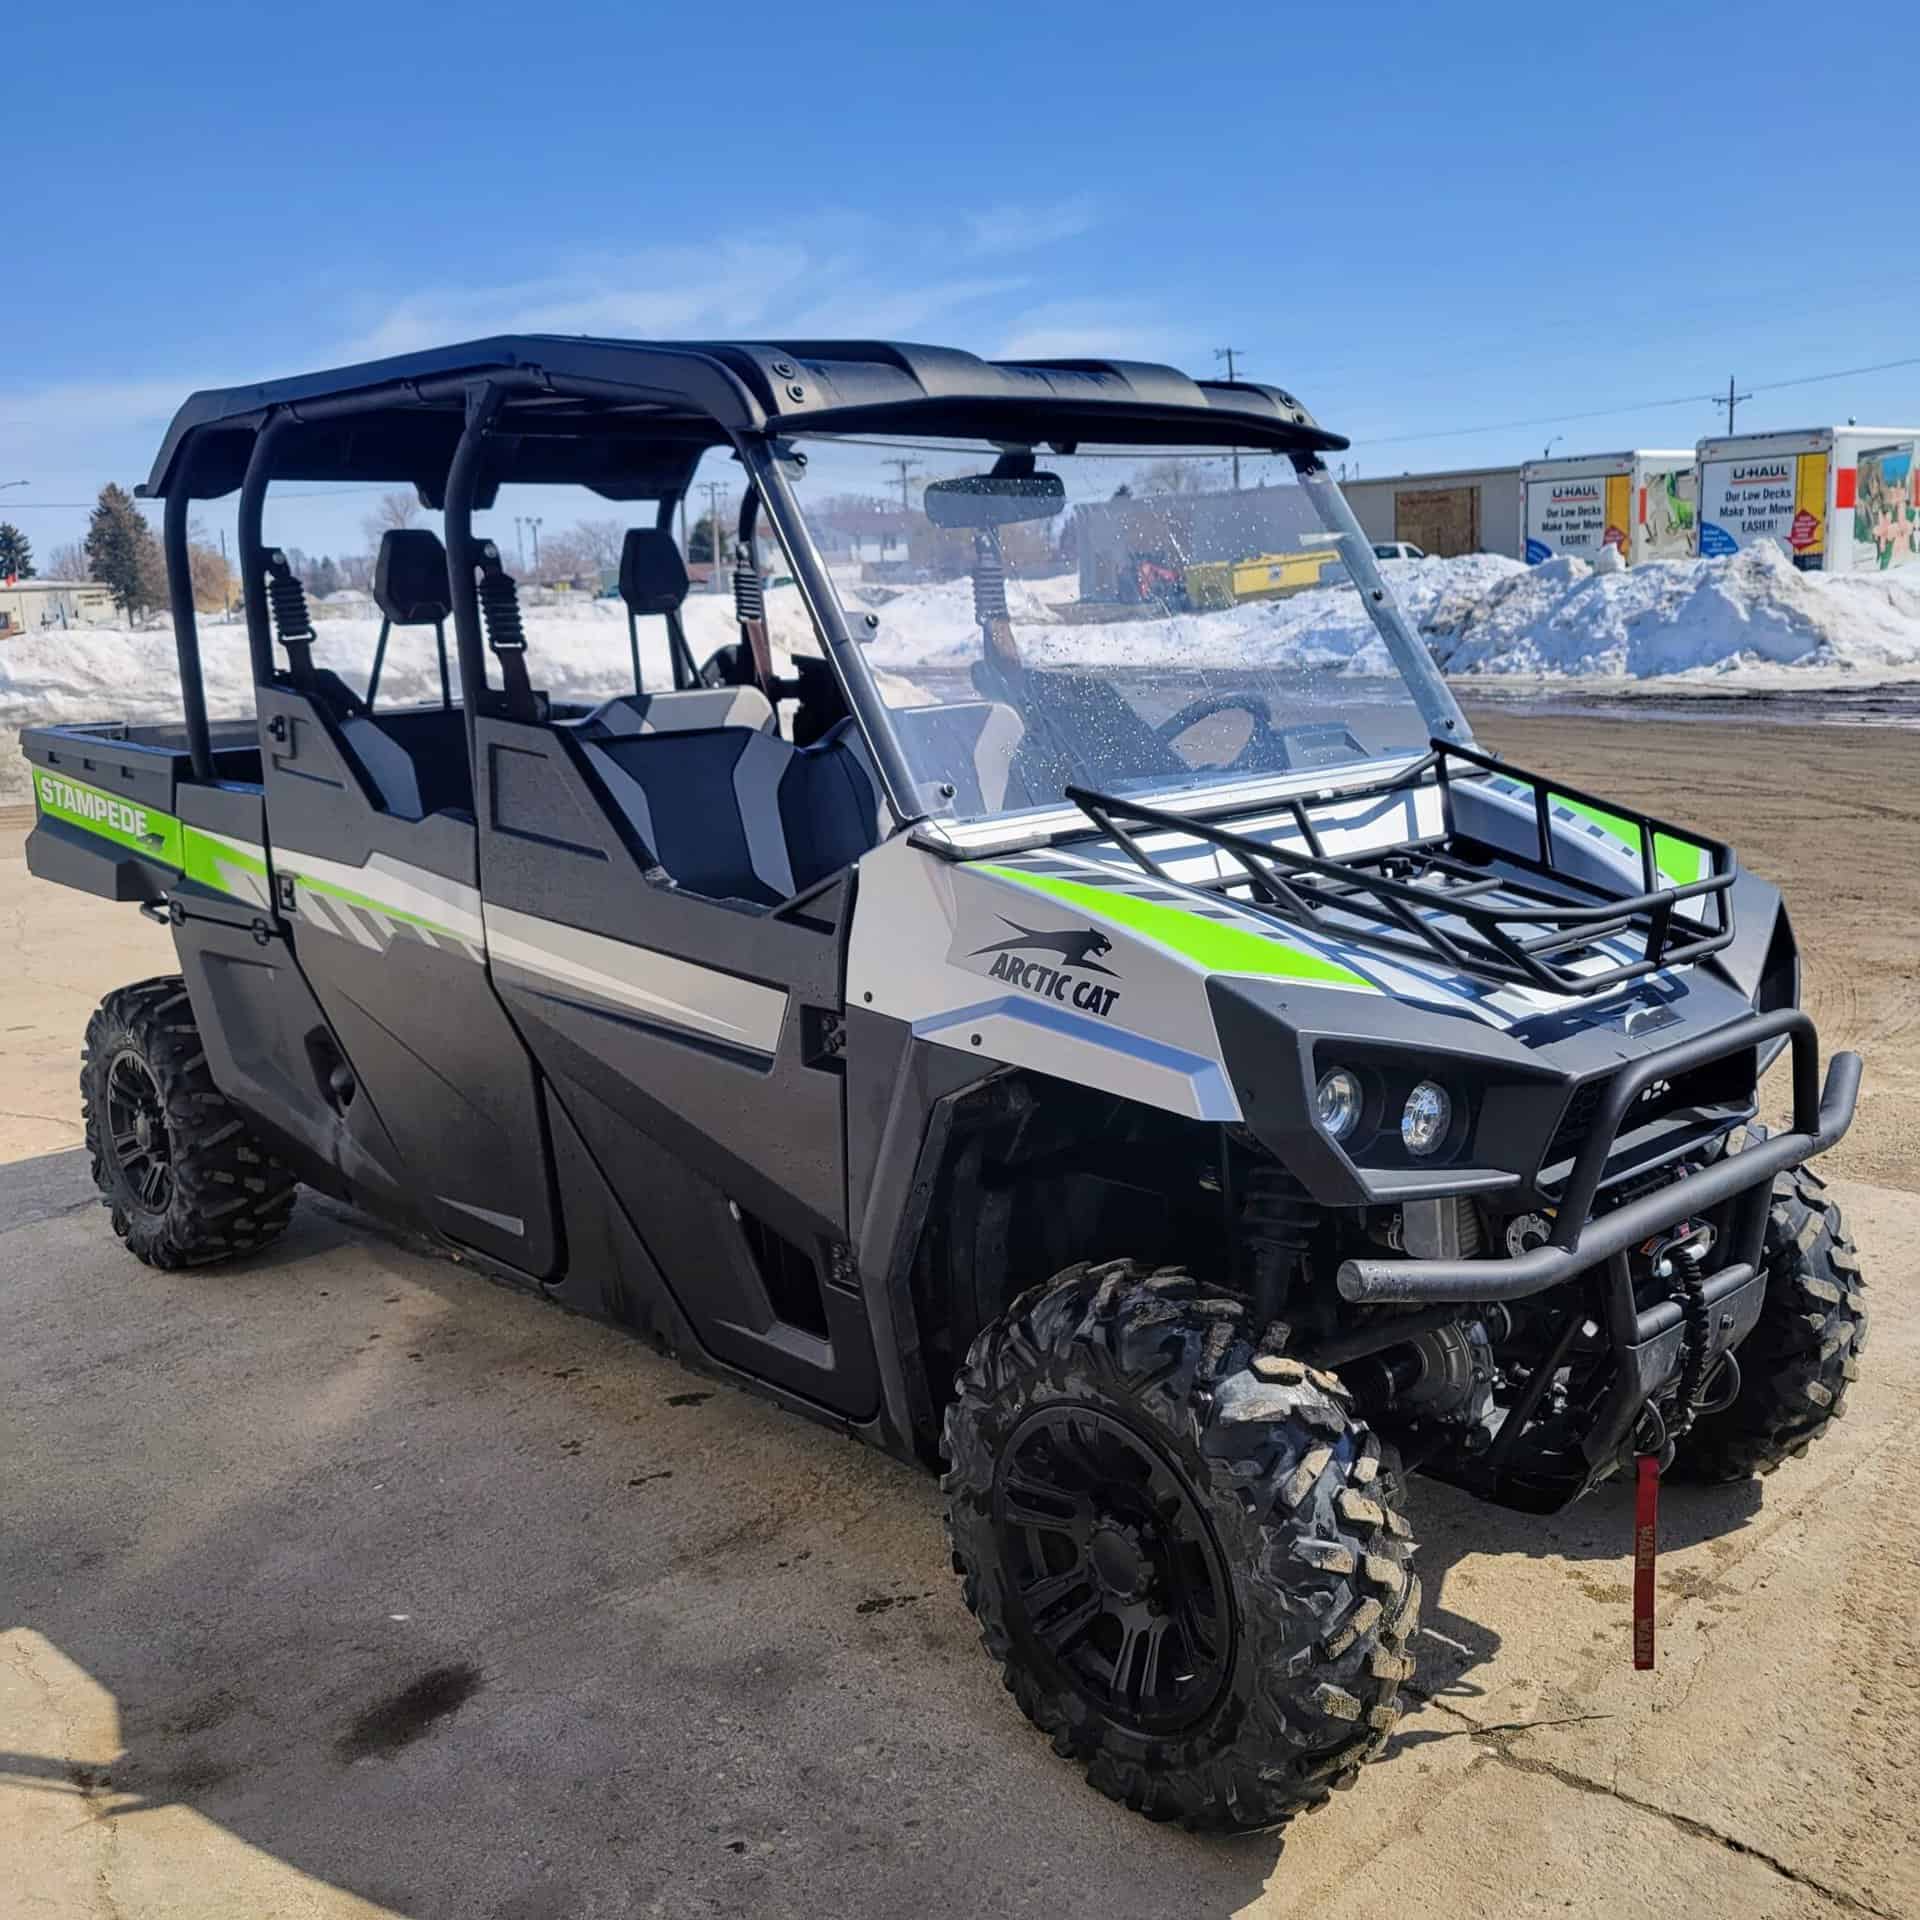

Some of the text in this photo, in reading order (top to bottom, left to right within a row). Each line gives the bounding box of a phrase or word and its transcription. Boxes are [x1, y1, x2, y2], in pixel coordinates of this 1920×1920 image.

[1732, 465, 1789, 479] U-HAUL
[1552, 484, 1599, 498] U-HAUL
[1725, 488, 1792, 502] Our Low Decks
[1578, 505, 1601, 516] Decks
[1719, 503, 1794, 518] Make Your Move
[1541, 521, 1563, 532] Make
[1583, 518, 1603, 529] Move
[1741, 520, 1778, 532] EASIER!
[40, 776, 148, 837] STAMPEDE
[988, 951, 1120, 1016] ARCTIC CAT
